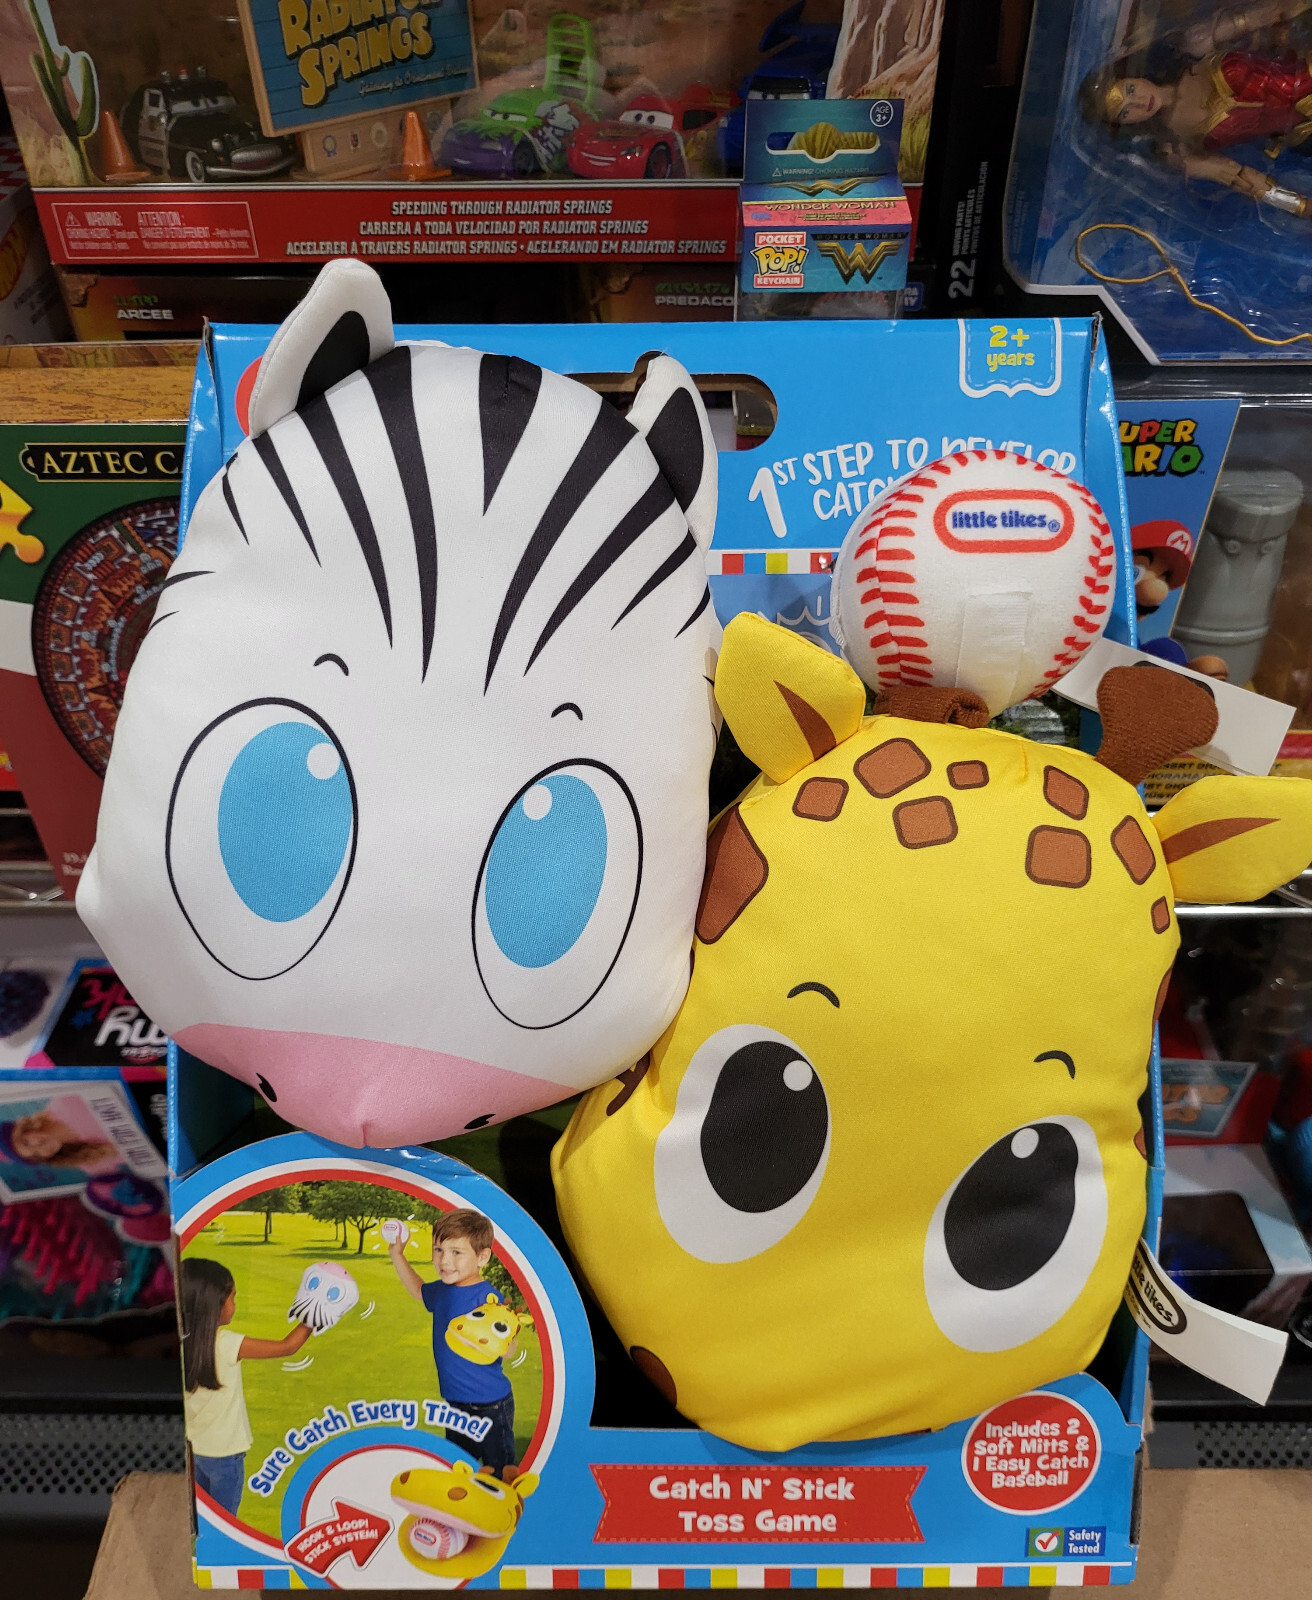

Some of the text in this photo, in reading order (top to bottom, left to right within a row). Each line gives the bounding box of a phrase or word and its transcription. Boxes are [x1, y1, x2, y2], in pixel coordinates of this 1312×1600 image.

[278, 0, 441, 56] RADIA
[298, 12, 433, 106] SPRINGS
[874, 105, 890, 114] AGE
[875, 114, 887, 122] 3+
[391, 200, 613, 215] SPEEDING THROUGH RADIATOR SPRINGS
[766, 201, 896, 211] WONDER WOMAN
[359, 220, 649, 235] CARRERA A TODA VELOCIDAD POR RADIATOR SPRINGS
[360, 241, 411, 254] TRAVERS
[413, 241, 467, 254] RADIATOR
[469, 240, 517, 254] SPRINGS
[526, 240, 599, 254] ACELERANDO
[601, 240, 618, 254] EM
[620, 240, 675, 254] RADIATOR
[677, 240, 727, 254] SPRINGS
[758, 234, 802, 244] POCKET
[754, 246, 807, 275] POP!
[757, 276, 801, 285] KEYCHAIN
[947, 258, 976, 299] 22
[655, 296, 735, 306] PREDACO
[116, 309, 174, 320] ARCEE
[989, 325, 1030, 347] 2+
[986, 352, 1036, 372] years
[1118, 418, 1198, 445] UPER
[42, 451, 184, 474] AZTEC C
[802, 441, 873, 486] STEP
[886, 437, 928, 470] TO
[813, 476, 894, 521] CATC
[952, 510, 998, 529] little
[1144, 1280, 1174, 1323] tikes
[985, 1418, 1080, 1438] Includes 2
[250, 1402, 490, 1494] Sure Catch Every Time!
[974, 1435, 1090, 1456] Soft Mitts &
[985, 1456, 1030, 1475] Easy
[1036, 1451, 1089, 1470] Catch
[649, 1473, 731, 1500] Catch
[782, 1476, 856, 1500] Stick
[992, 1470, 1070, 1488] Baseball
[678, 1508, 837, 1532] Toss Game
[296, 1529, 325, 1553] HOOK
[336, 1518, 369, 1532] LOOP!
[304, 1528, 379, 1564] STICK SYSTEM!
[1068, 1529, 1102, 1542] Safety
[1068, 1542, 1100, 1554] Tested
